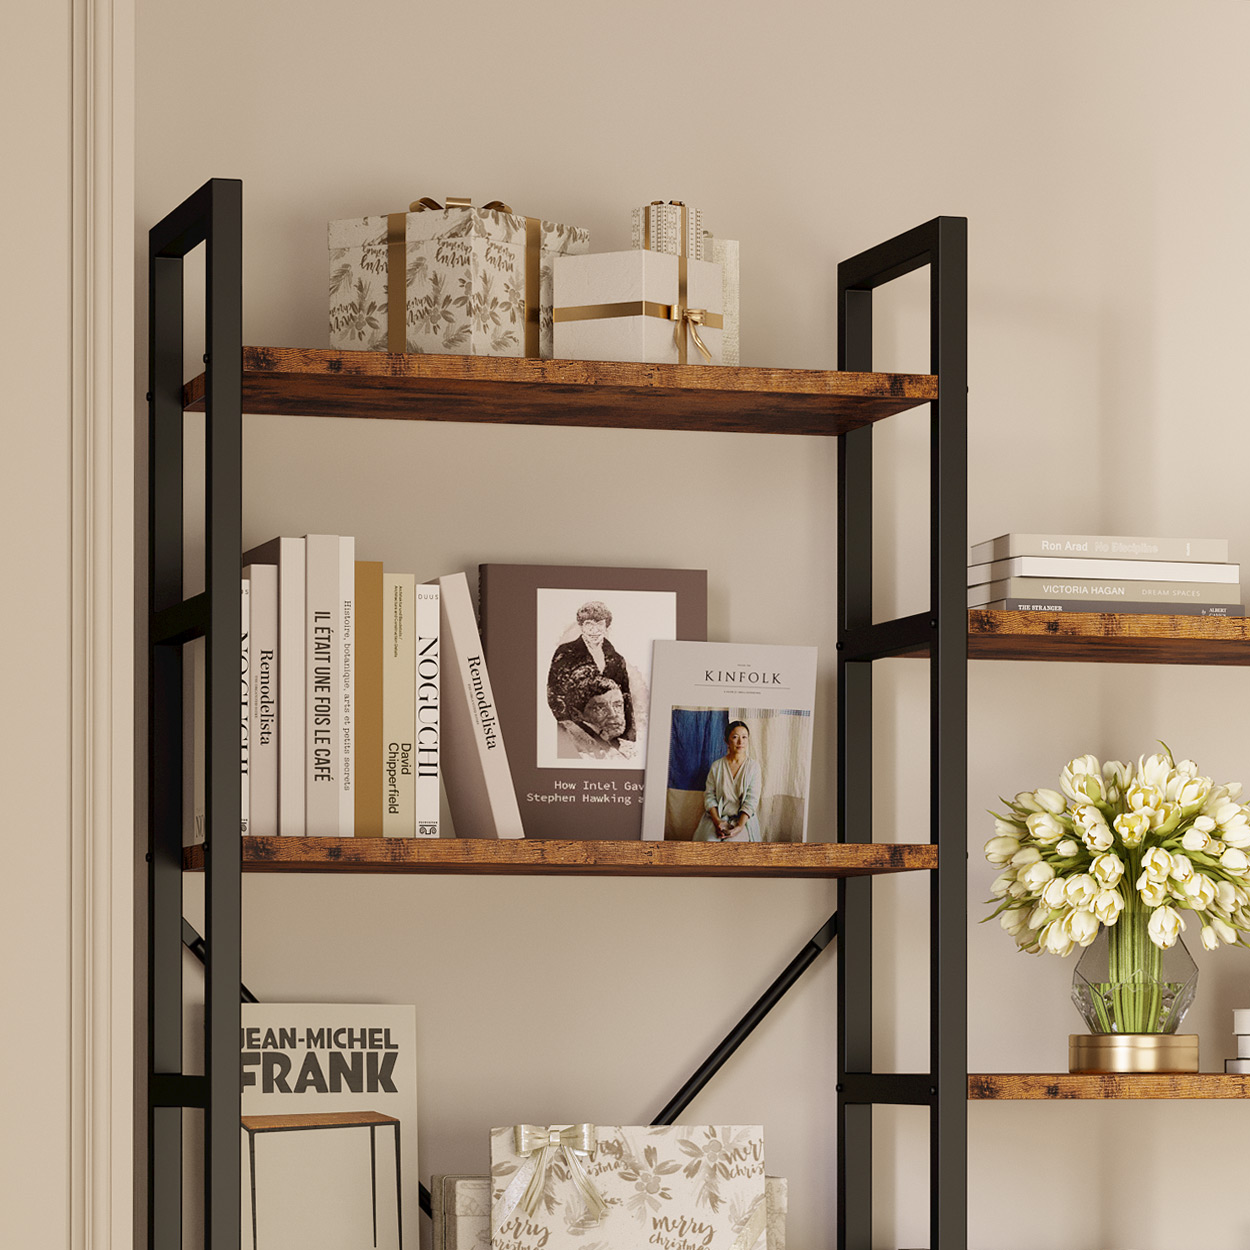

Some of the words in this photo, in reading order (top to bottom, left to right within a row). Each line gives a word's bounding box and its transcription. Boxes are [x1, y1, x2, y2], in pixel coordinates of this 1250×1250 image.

[1042, 541, 1062, 550] Ron
[1065, 542, 1088, 551] Arad
[1043, 585, 1089, 594] VICTORIA
[1092, 586, 1125, 595] HAGAN
[314, 610, 330, 622] IL
[314, 627, 334, 663] ÉTAIT
[314, 668, 330, 693] UNE
[704, 670, 782, 685] KINFOLK
[260, 649, 274, 745] Remodelista
[314, 697, 330, 725] FOIS
[418, 636, 438, 779] NOGUCHI
[467, 656, 496, 750] Remodelista
[314, 728, 330, 744] LE
[314, 746, 334, 781] CAFÉ
[400, 744, 411, 774] David
[388, 742, 399, 814] Chipperfield
[554, 781, 576, 790] How
[583, 781, 618, 791] Intel
[624, 781, 645, 791] Gav
[527, 792, 576, 805] Stephen
[582, 794, 631, 805] Hawking
[241, 1052, 398, 1093] FRANK
[652, 1215, 716, 1246] merry
